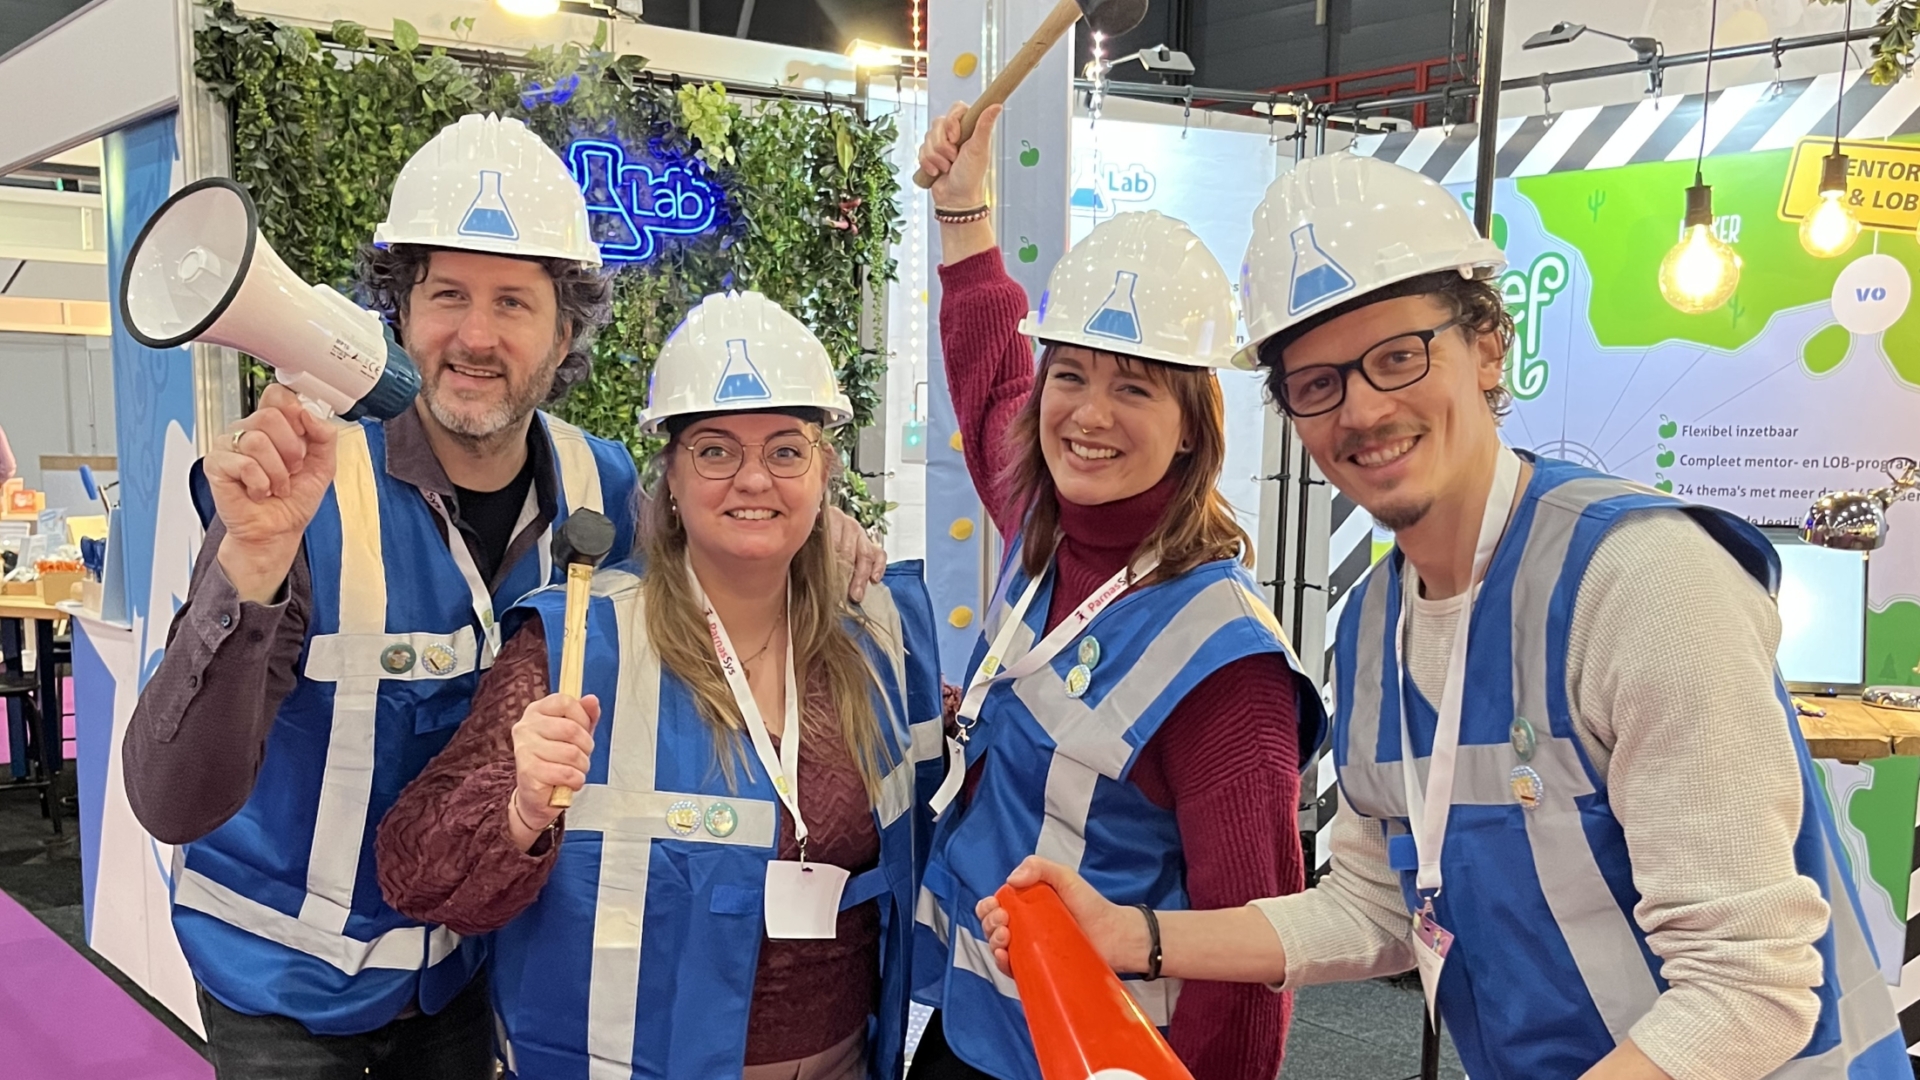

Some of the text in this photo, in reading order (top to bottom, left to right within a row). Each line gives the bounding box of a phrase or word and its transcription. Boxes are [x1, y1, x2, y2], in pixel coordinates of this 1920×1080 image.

[1846, 158, 1920, 182] ENTOR
[1108, 171, 1149, 193] Lab
[631, 178, 702, 220] Lab
[1848, 188, 1920, 211] & LOB
[1682, 425, 1799, 437] Flexibel inzetbaar
[1679, 454, 1742, 470] Compleet
[1744, 457, 1799, 468] mentor-
[1802, 458, 1819, 468] en
[1677, 483, 1694, 496] 24
[1697, 484, 1747, 497] thema's
[1750, 487, 1776, 498] met
[1780, 489, 1815, 499] meer
[709, 622, 736, 676] ParnasSys
